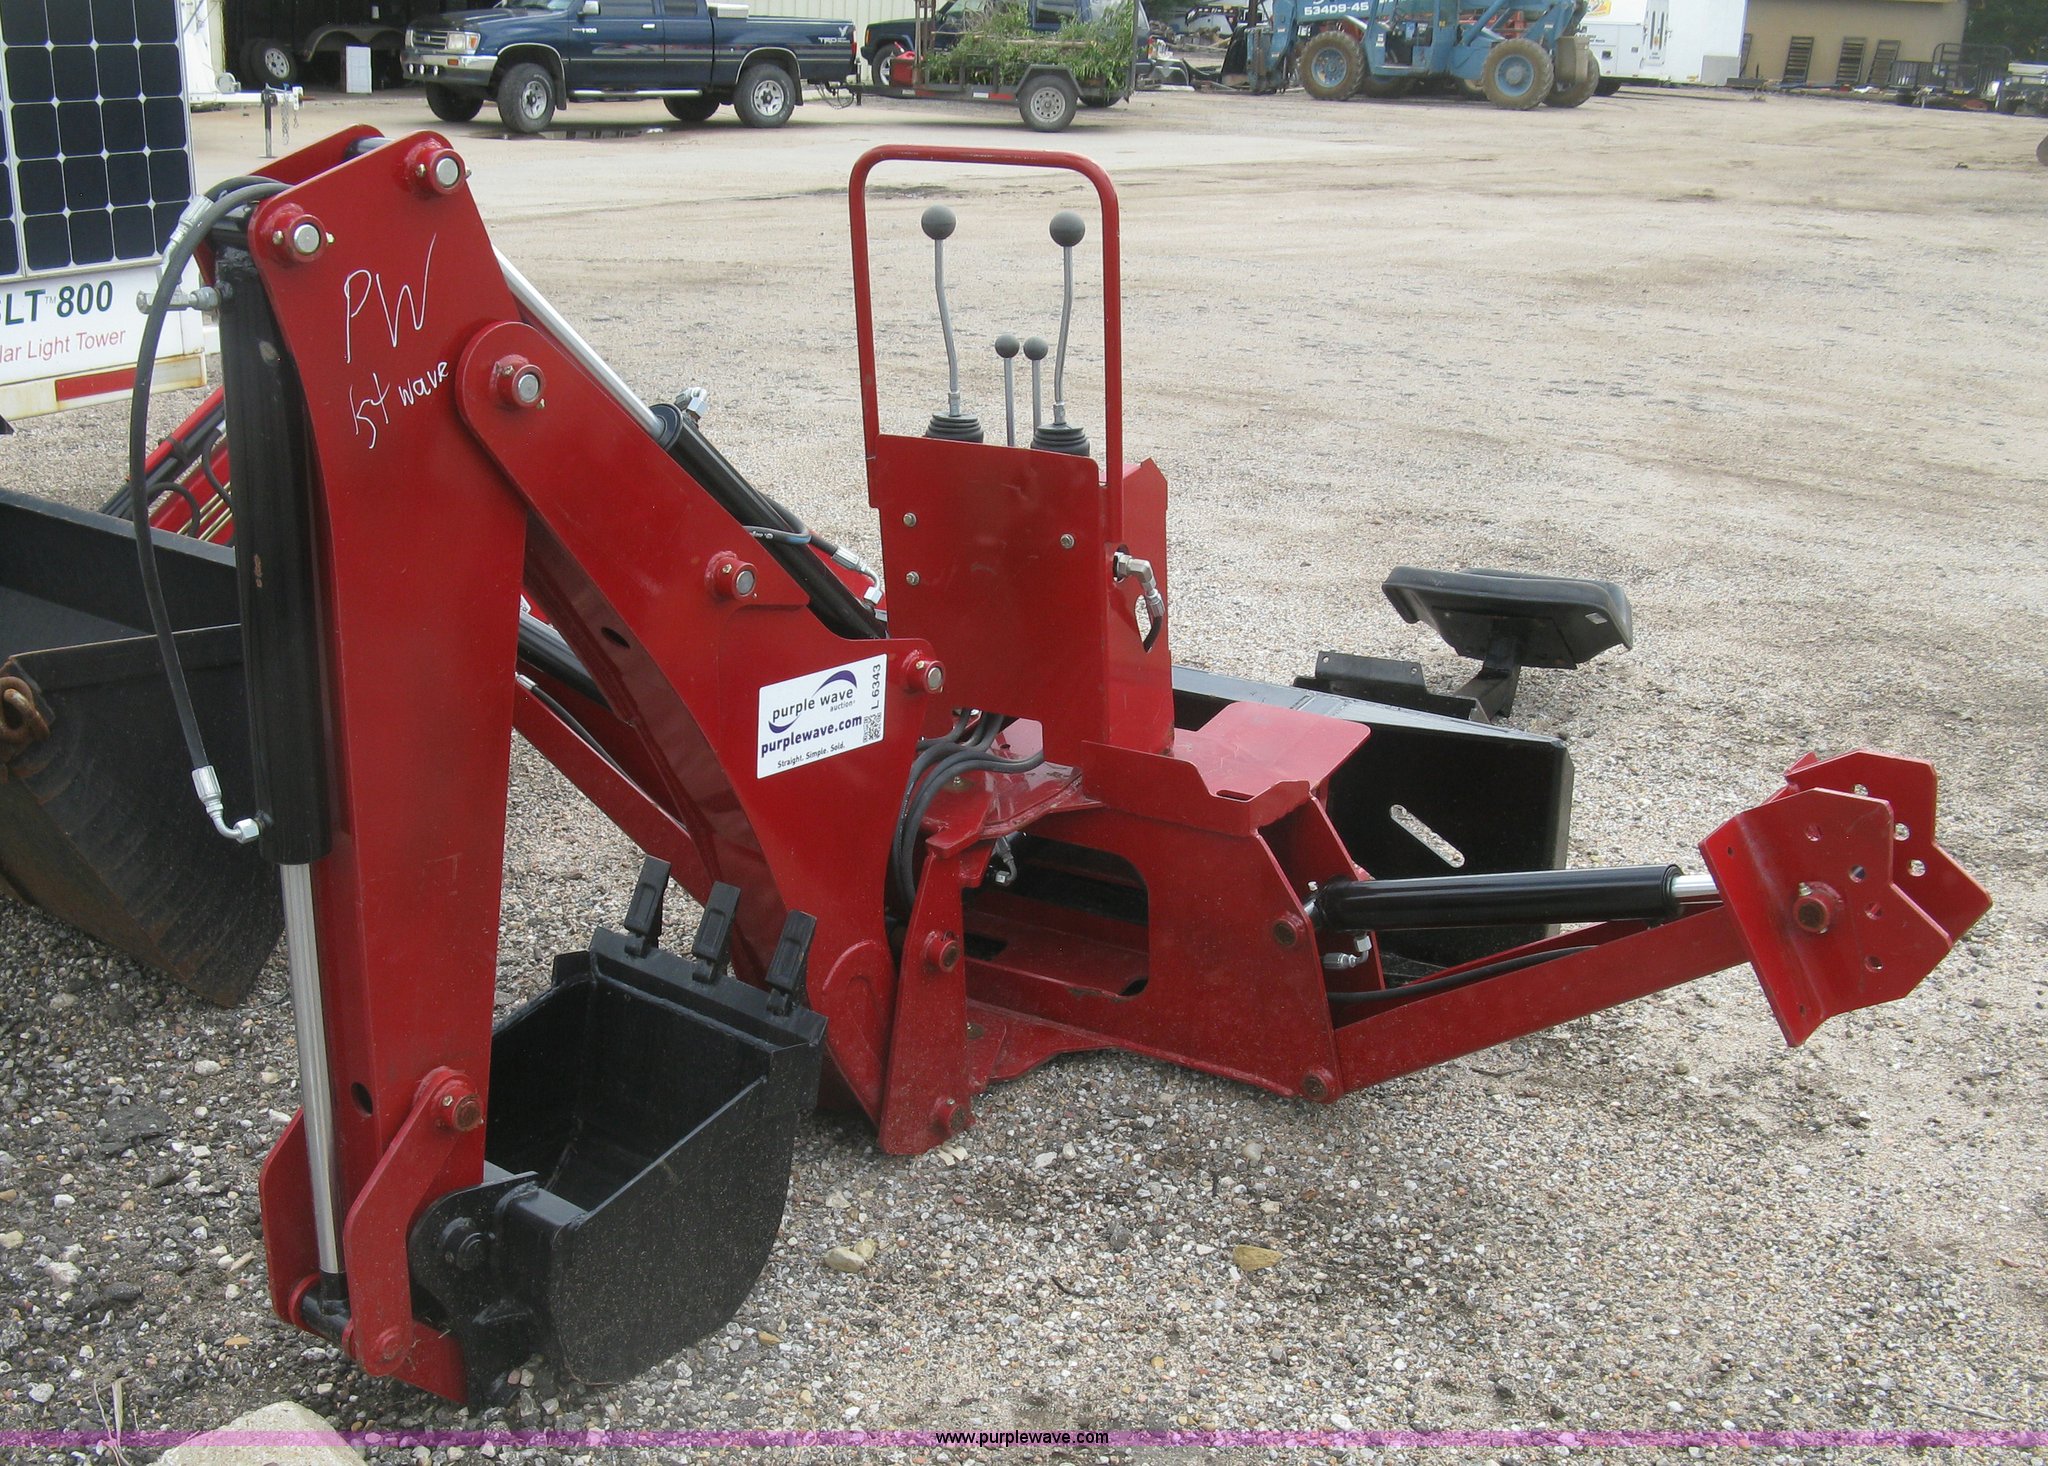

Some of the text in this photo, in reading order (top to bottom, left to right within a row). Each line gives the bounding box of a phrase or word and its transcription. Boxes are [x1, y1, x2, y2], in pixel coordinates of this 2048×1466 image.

[0, 289, 46, 326] LT
[56, 280, 113, 318] 800
[344, 232, 437, 364] PW
[27, 336, 70, 361] Light
[76, 330, 126, 350] Tower
[399, 361, 449, 407] wave
[871, 664, 881, 697] 6343
[772, 688, 854, 723] purple wave
[830, 700, 853, 712] auction
[761, 715, 862, 758] purplewave.com
[777, 741, 845, 769] Straight. Simple. Sold.
